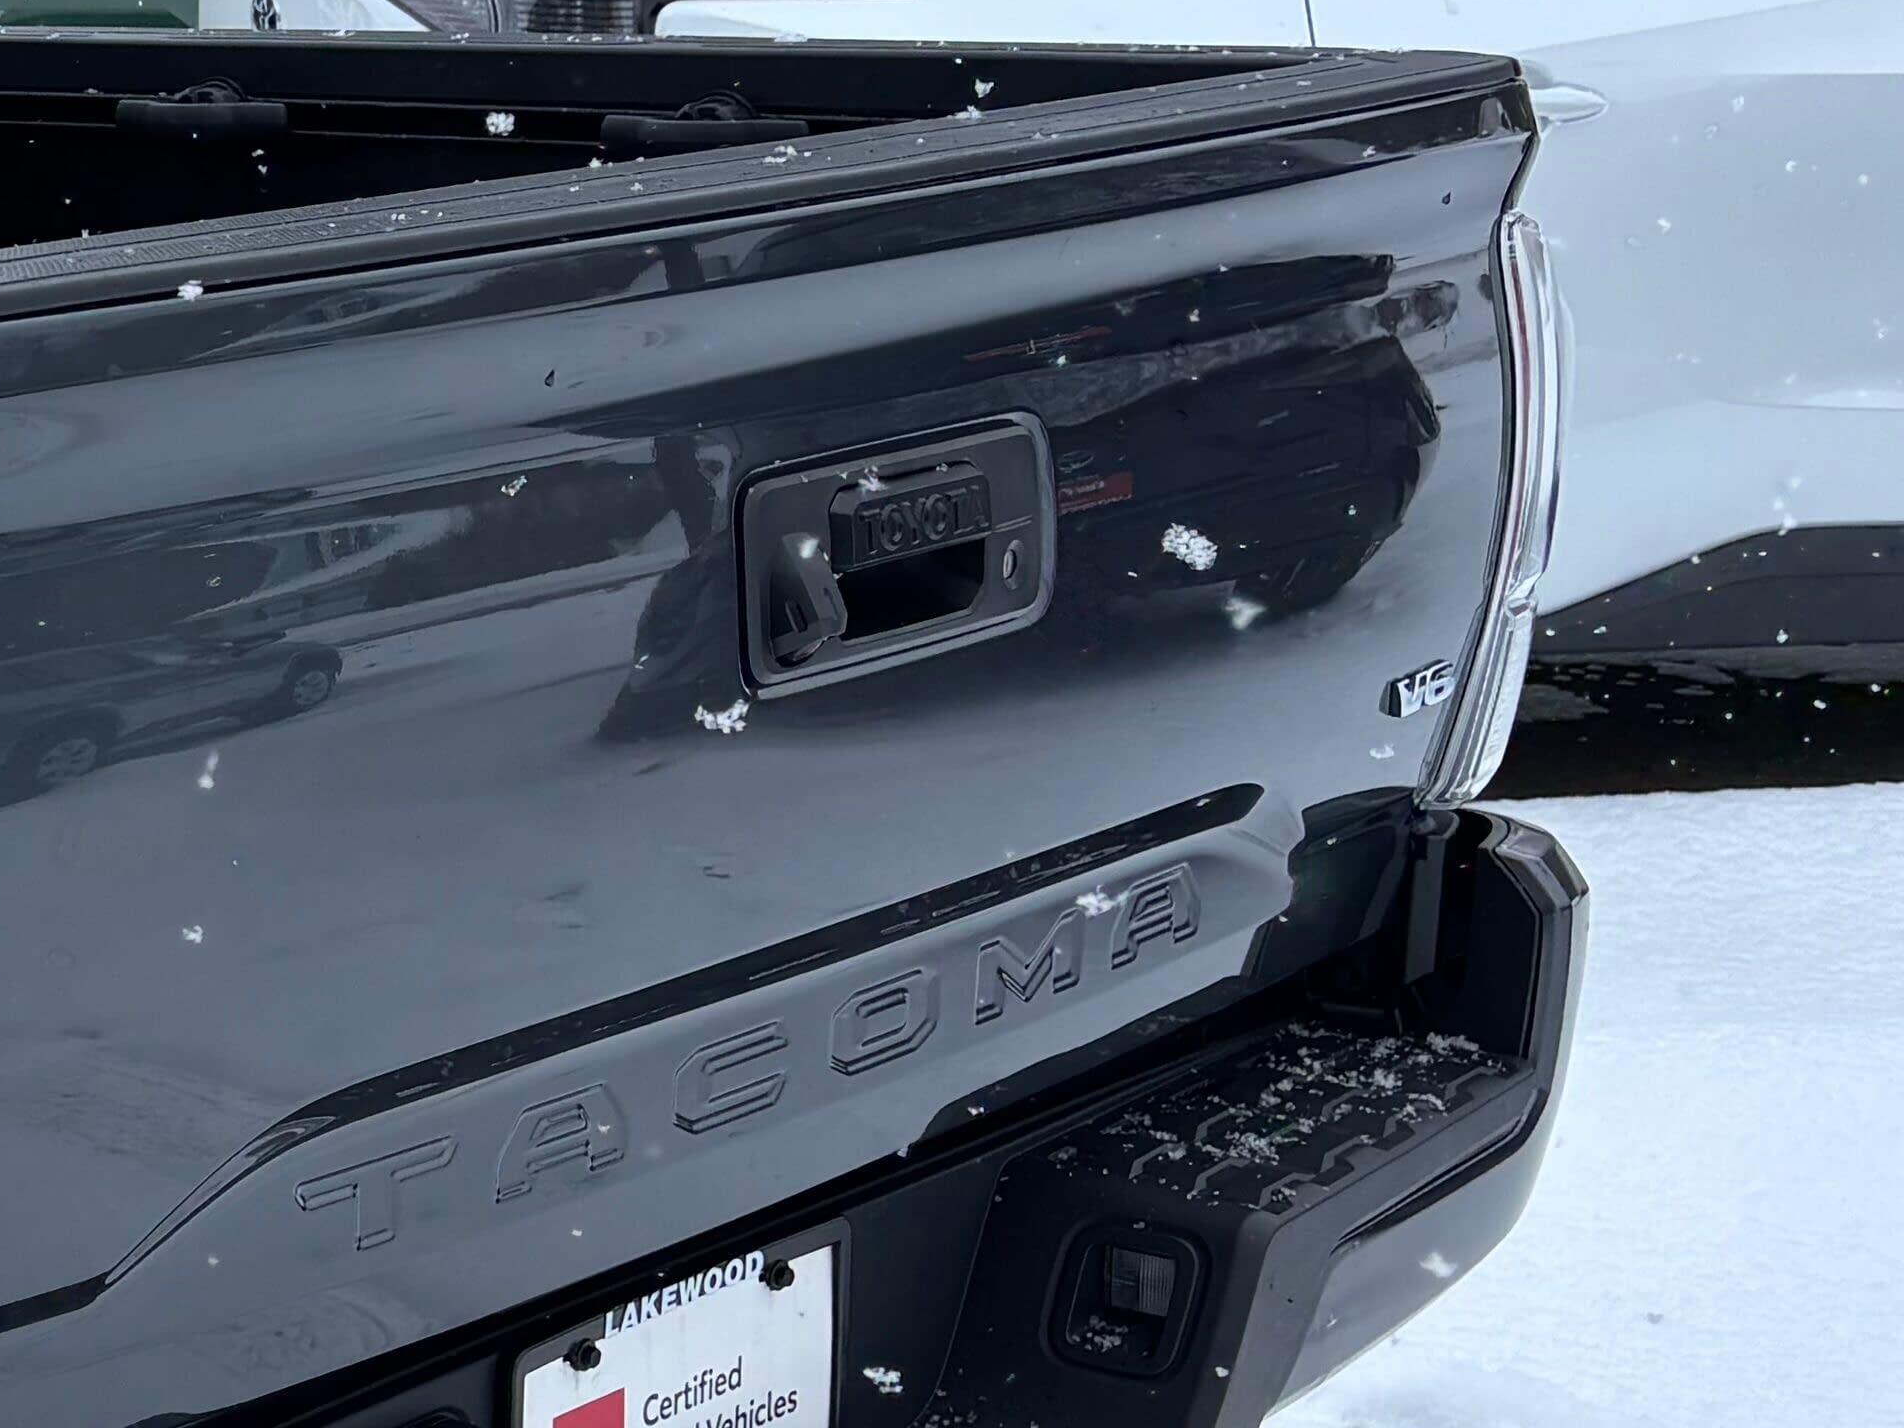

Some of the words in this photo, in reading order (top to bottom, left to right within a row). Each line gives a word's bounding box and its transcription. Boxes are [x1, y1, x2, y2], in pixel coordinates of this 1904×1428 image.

[859, 484, 991, 556] TOYOTA
[1397, 659, 1456, 720] V6
[294, 861, 1198, 1252] TACOMA
[604, 1250, 765, 1339] LAKEWOOD
[642, 1355, 743, 1427] Certified
